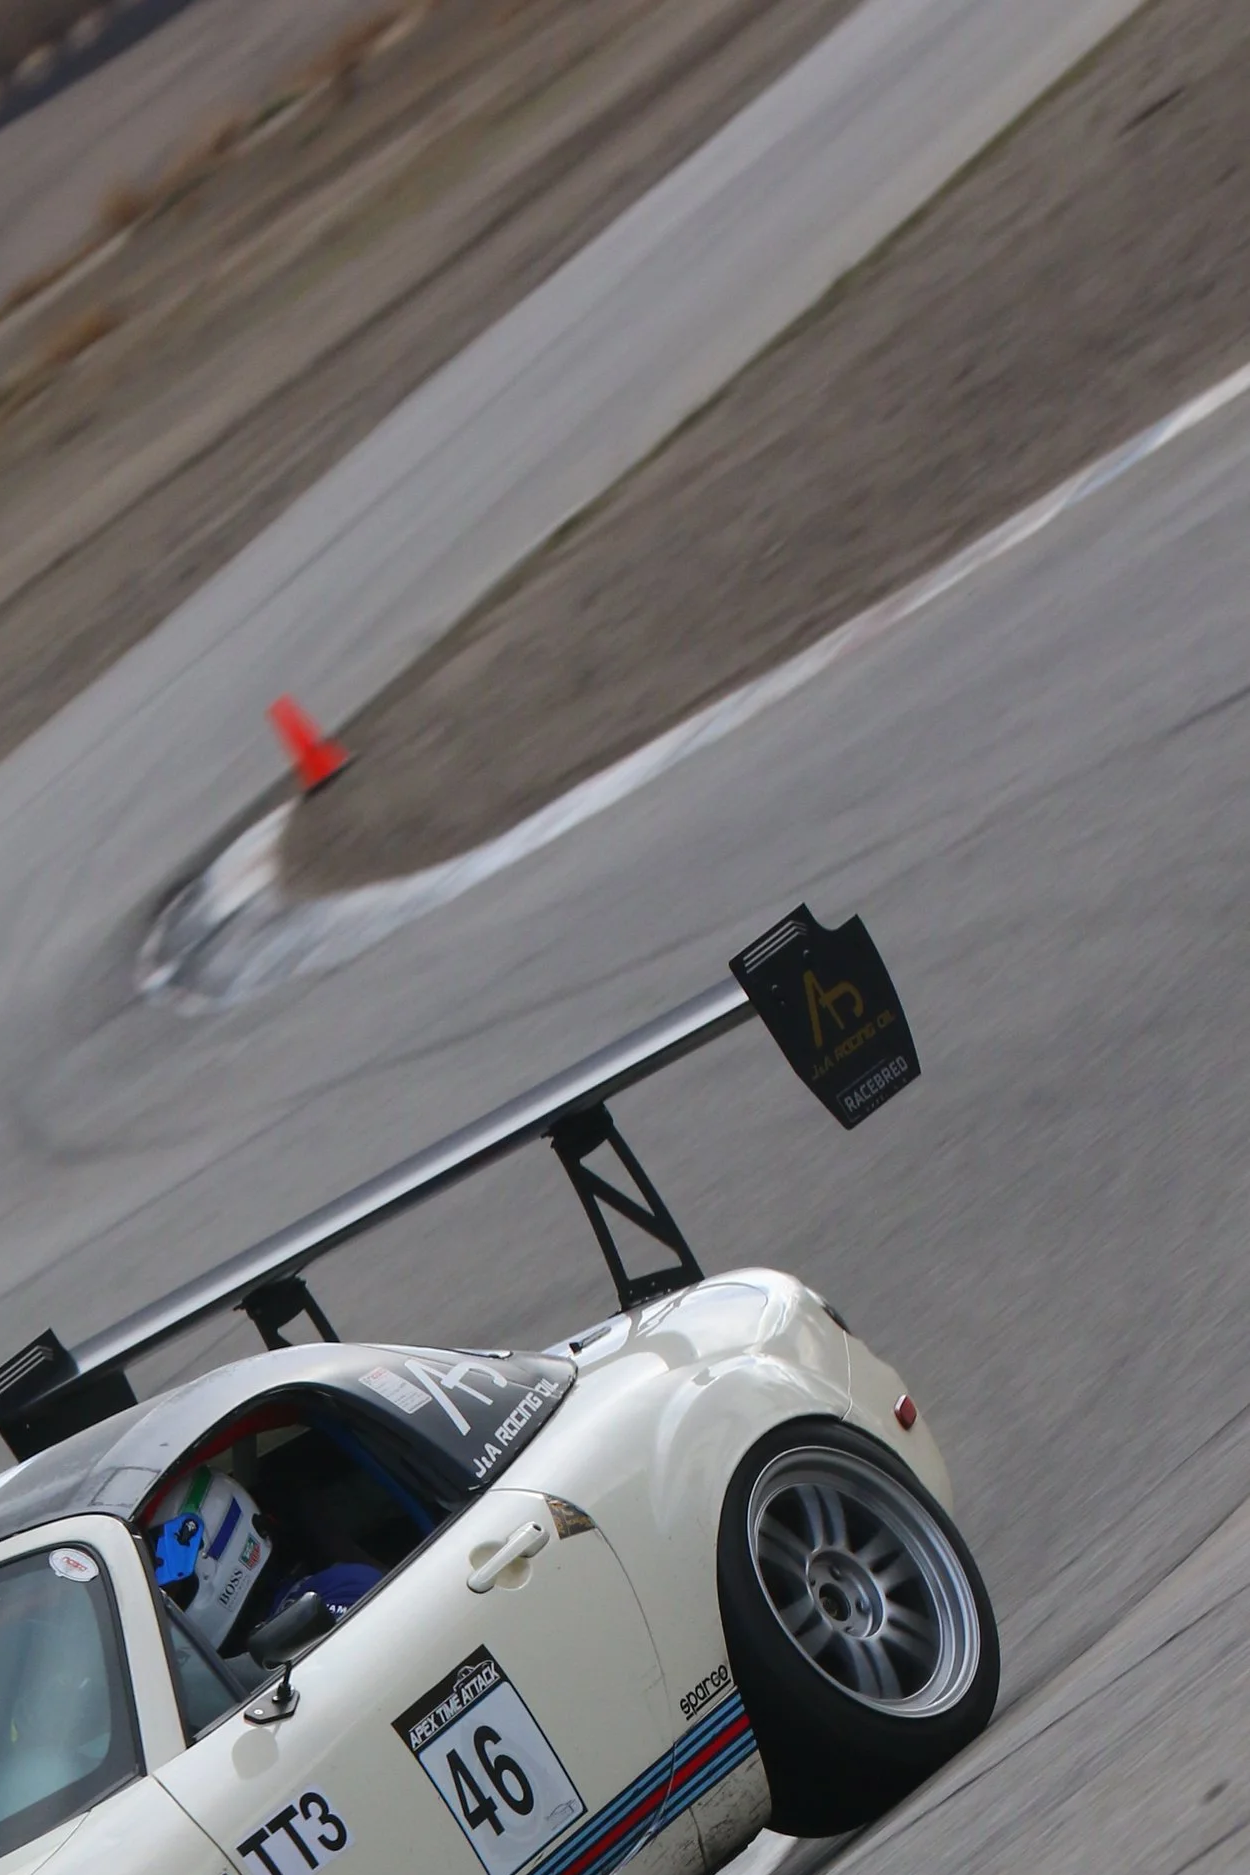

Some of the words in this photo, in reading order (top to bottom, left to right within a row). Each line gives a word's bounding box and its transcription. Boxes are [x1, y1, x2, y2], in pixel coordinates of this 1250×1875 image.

[844, 1055, 909, 1113] RACEBRED
[494, 1391, 544, 1447] RACING
[534, 1377, 560, 1398] OIL
[219, 1568, 244, 1606] BOSS
[409, 1713, 440, 1750] APEX
[435, 1693, 463, 1724] TIME
[460, 1661, 501, 1706] ATTACK
[679, 1664, 730, 1719] sparco
[446, 1725, 535, 1837] 46
